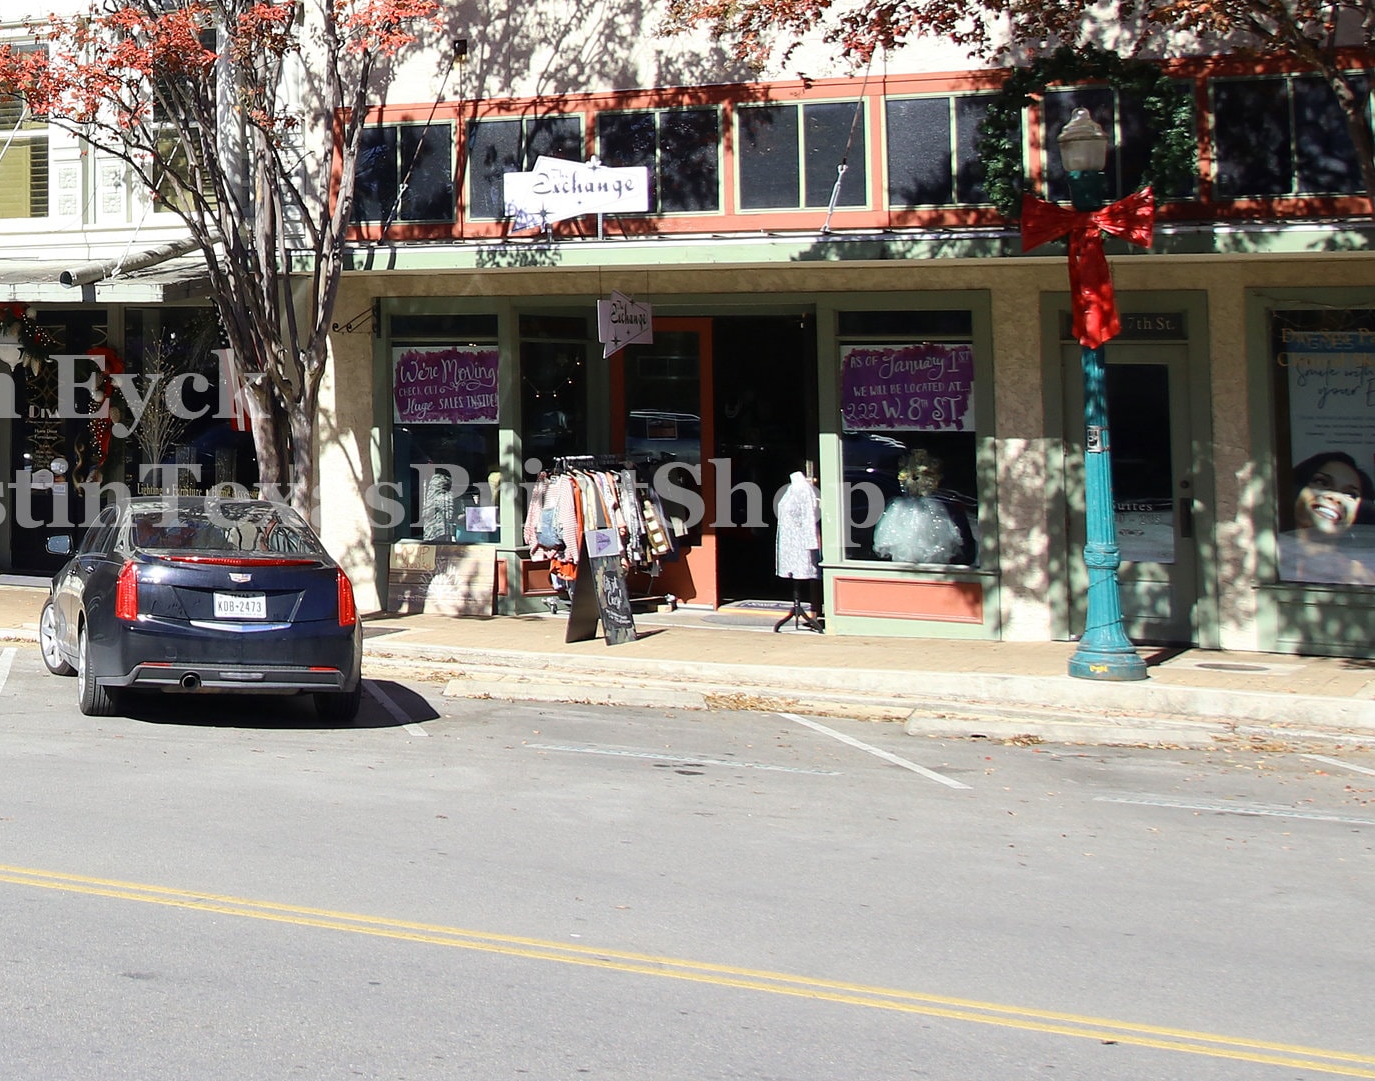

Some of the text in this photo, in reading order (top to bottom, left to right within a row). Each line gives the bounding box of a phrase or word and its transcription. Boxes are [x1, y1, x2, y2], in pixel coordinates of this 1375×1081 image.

[532, 171, 635, 200] Exchange
[1155, 317, 1175, 331] St.
[400, 359, 496, 389] We're Moving
[850, 356, 863, 368] AS
[865, 355, 879, 366] OF
[879, 354, 944, 380] January
[853, 385, 867, 396] WE
[869, 384, 887, 395] WILL
[890, 383, 902, 394] BE
[904, 381, 944, 393] LOCATED
[402, 398, 434, 419] Huge
[439, 396, 464, 410] SALES
[846, 402, 880, 420] 222
[882, 397, 904, 419] W.
[932, 394, 963, 421] ST.
[137, 482, 162, 497] Lighting
